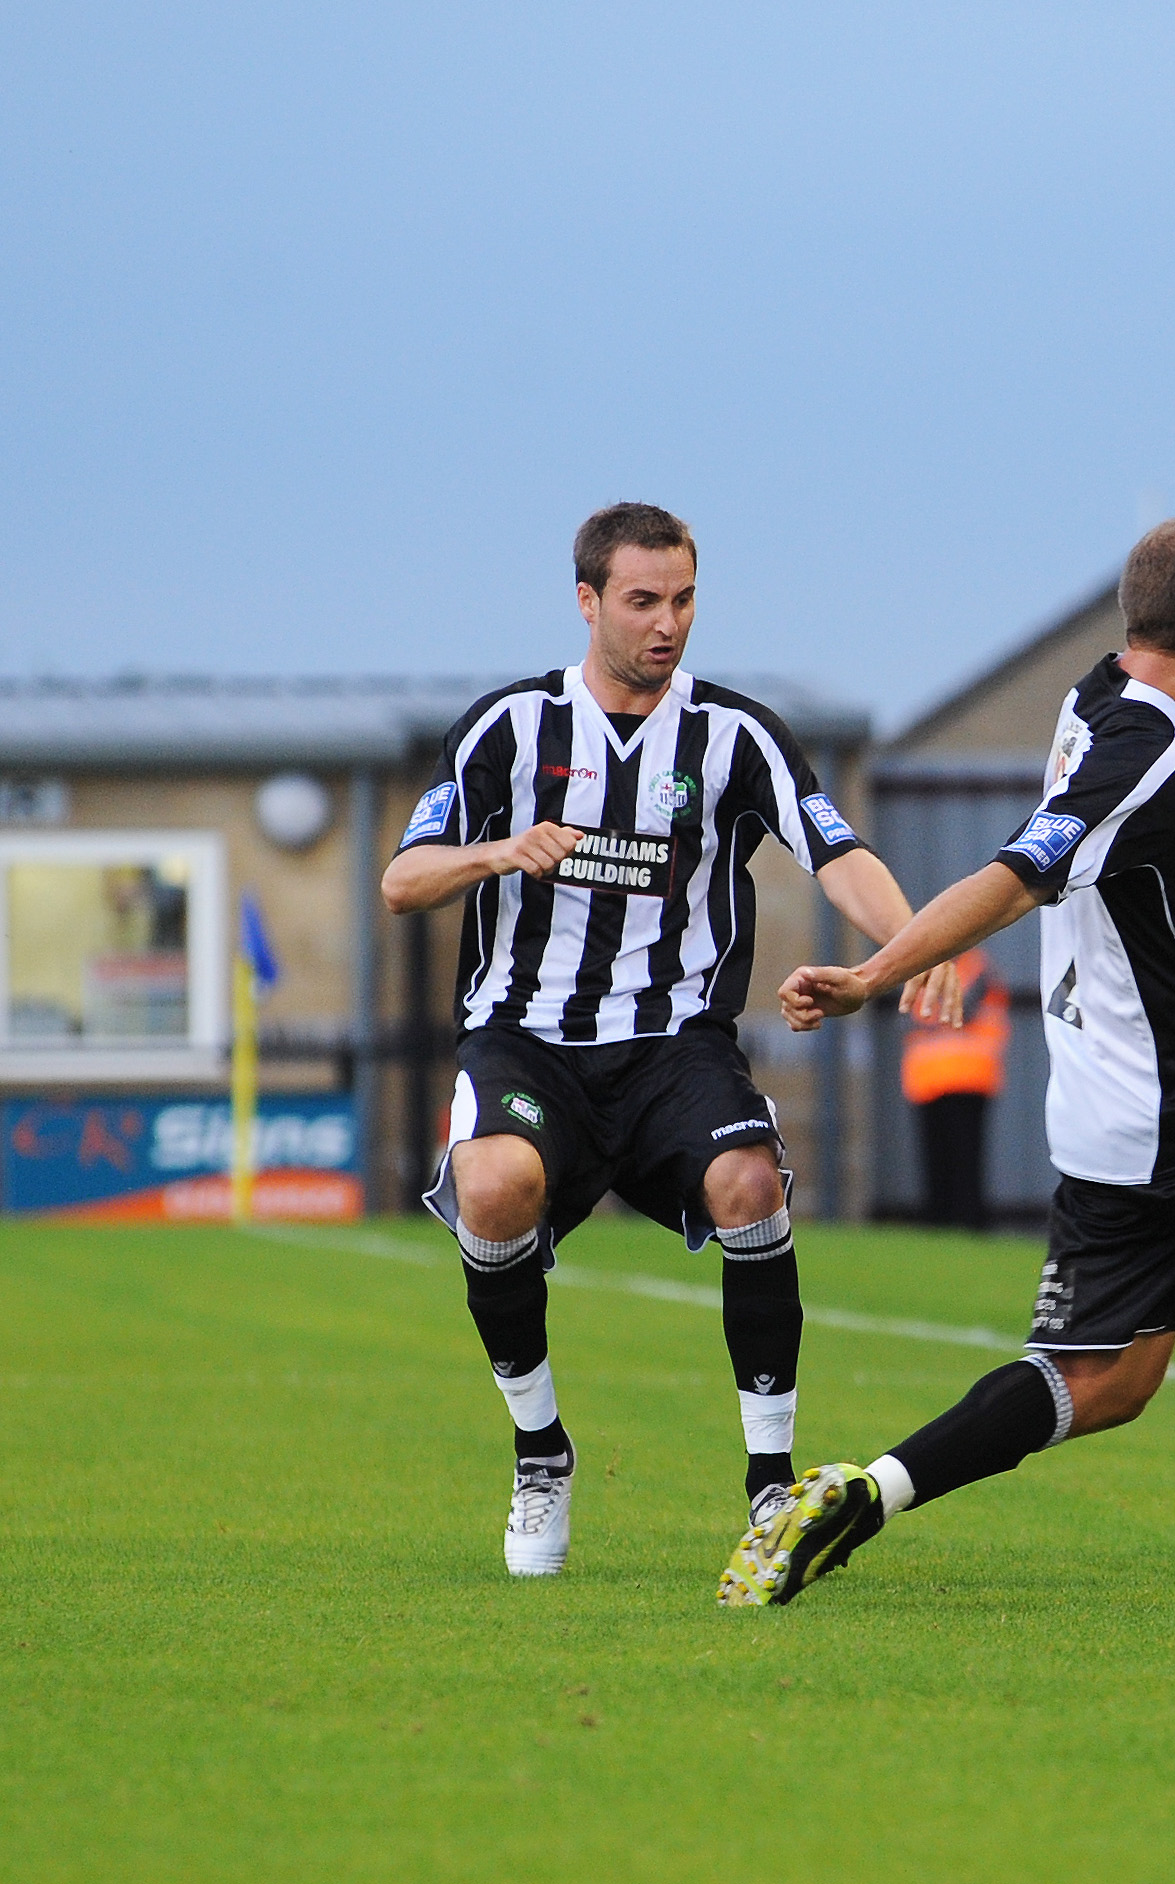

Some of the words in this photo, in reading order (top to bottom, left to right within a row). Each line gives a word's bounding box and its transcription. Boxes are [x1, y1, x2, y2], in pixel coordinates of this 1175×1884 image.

[1031, 816, 1082, 841] BLUE
[574, 833, 669, 864] WILLIAMS
[558, 857, 652, 888] BUILDING
[150, 1104, 350, 1170] Sins
